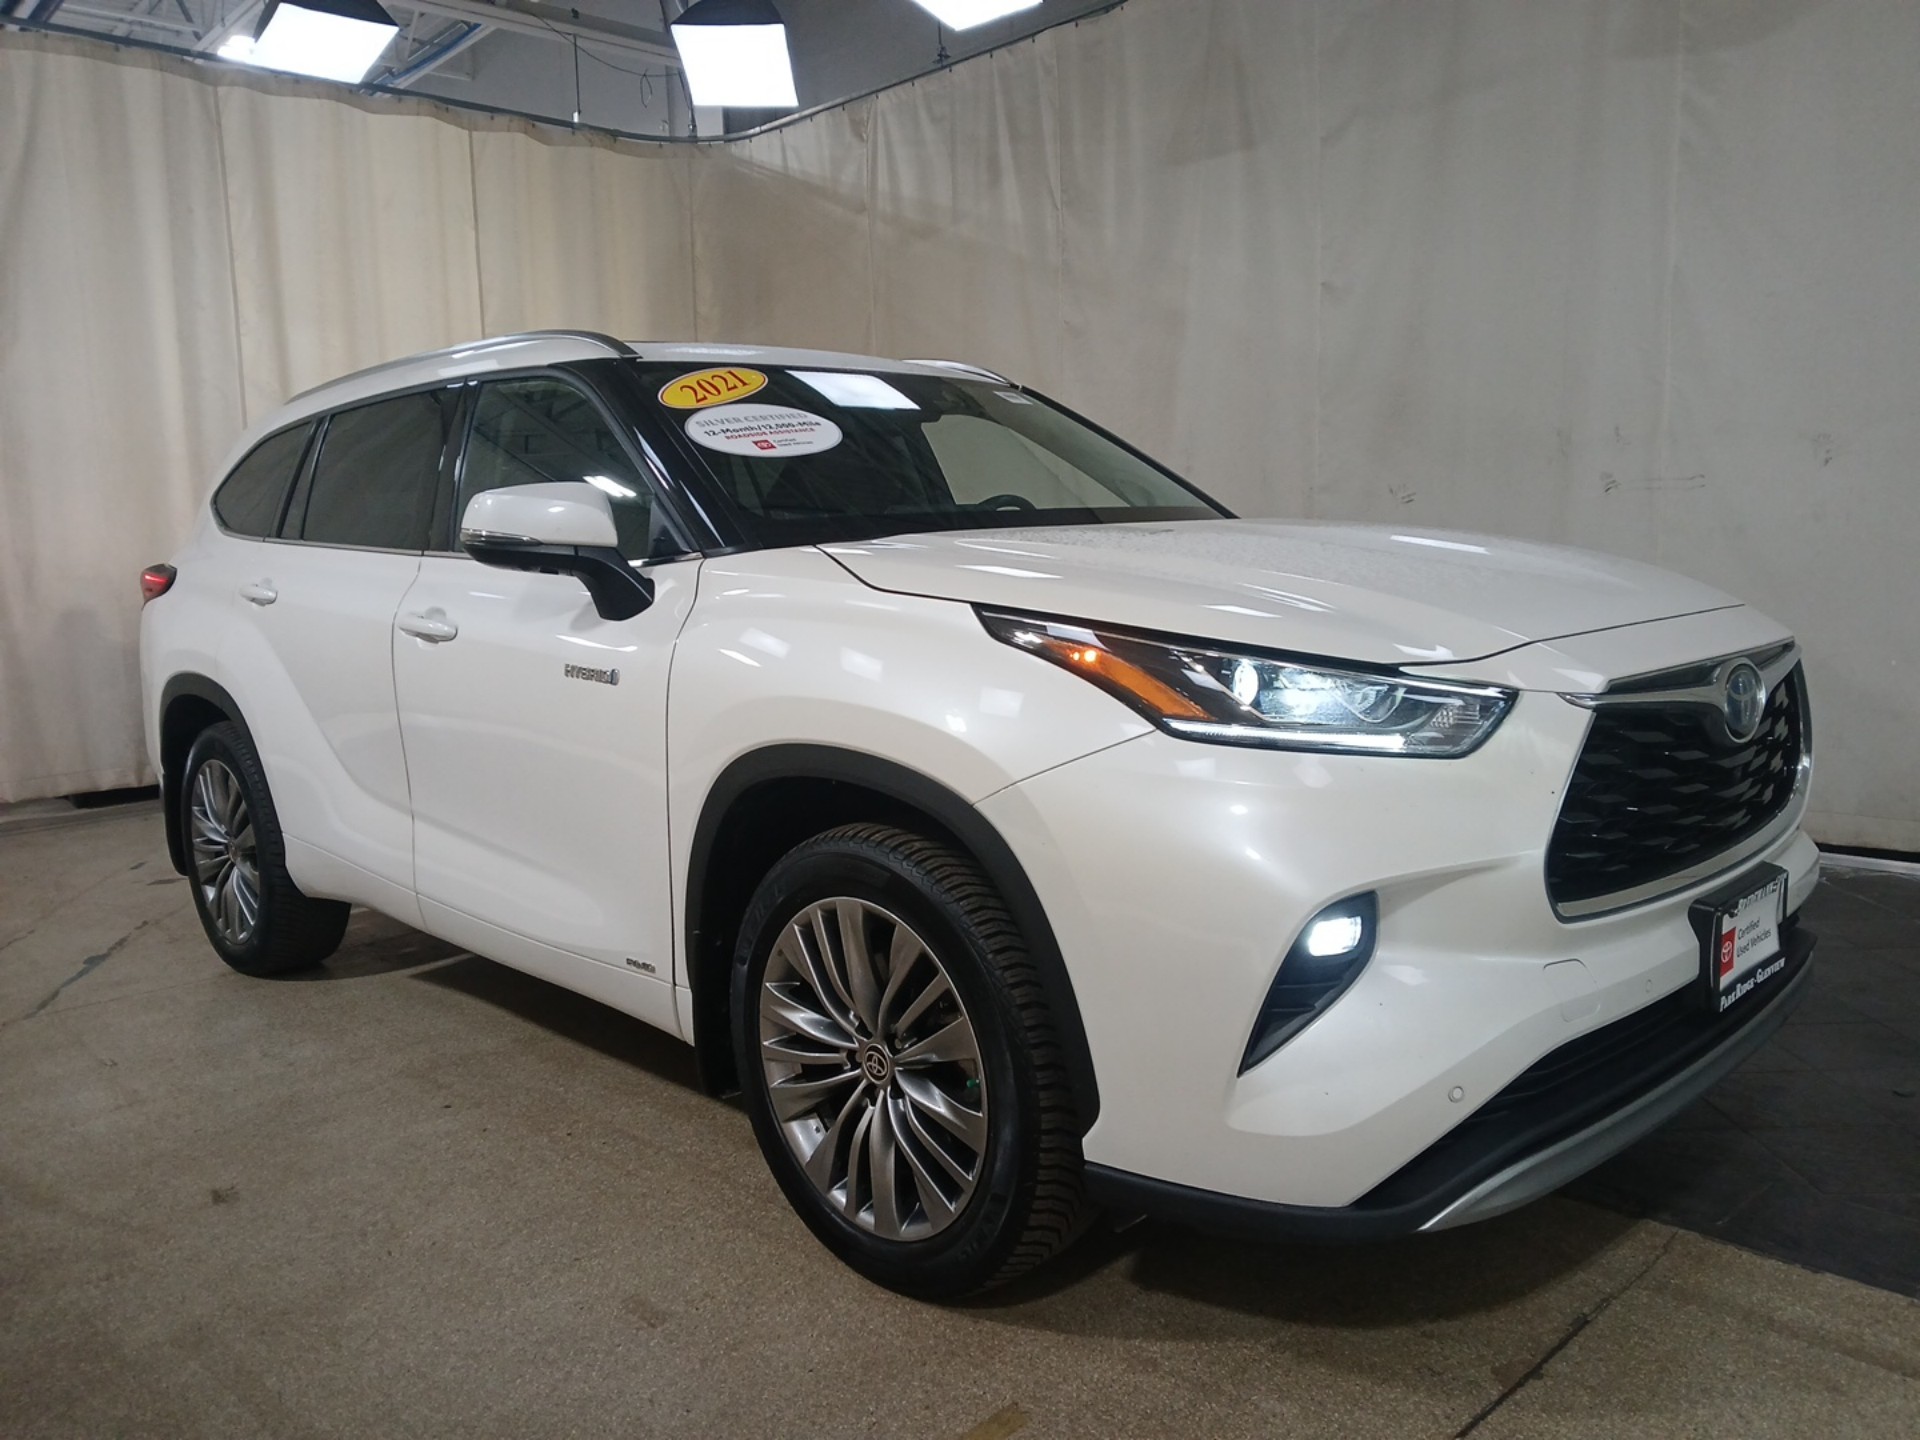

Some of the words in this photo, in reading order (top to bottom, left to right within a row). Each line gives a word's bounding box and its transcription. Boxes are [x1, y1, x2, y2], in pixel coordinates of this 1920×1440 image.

[680, 370, 750, 404] 2021
[696, 416, 742, 428] SILVER
[743, 413, 808, 424] CERTIFIED
[724, 431, 768, 441] ROADSIDE
[1737, 917, 1760, 940] Certified
[1737, 939, 1750, 958] Used
[1751, 927, 1772, 948] Vehicles
